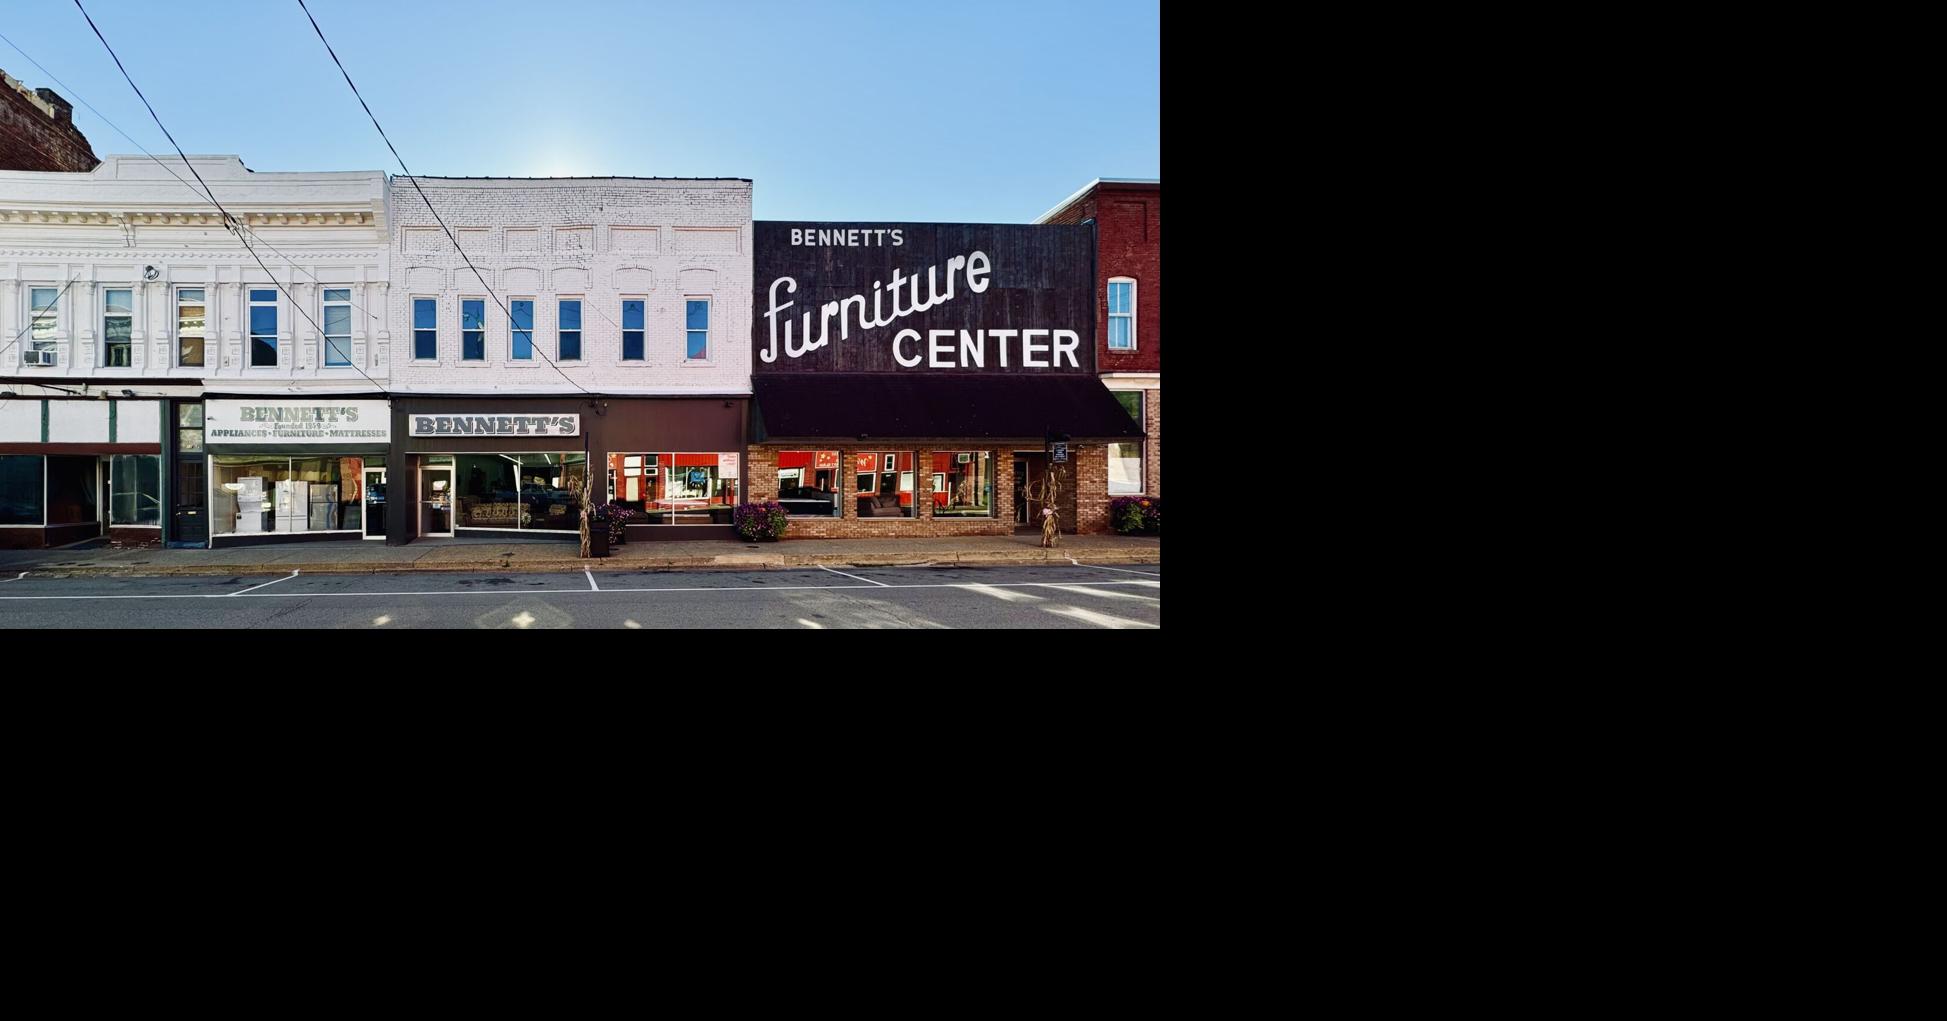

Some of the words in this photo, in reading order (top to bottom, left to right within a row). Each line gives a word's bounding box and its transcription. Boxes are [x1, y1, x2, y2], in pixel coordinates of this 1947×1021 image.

[791, 228, 904, 247] BENNETT'S
[759, 250, 992, 364] furniture
[892, 328, 1080, 369] CENTER
[240, 406, 359, 423] BENNETT'S
[211, 429, 268, 438] APPLIANCES
[272, 429, 325, 438] FURNITURE
[329, 429, 387, 438] MATTRESSES
[415, 416, 576, 435] BENNETT'S
